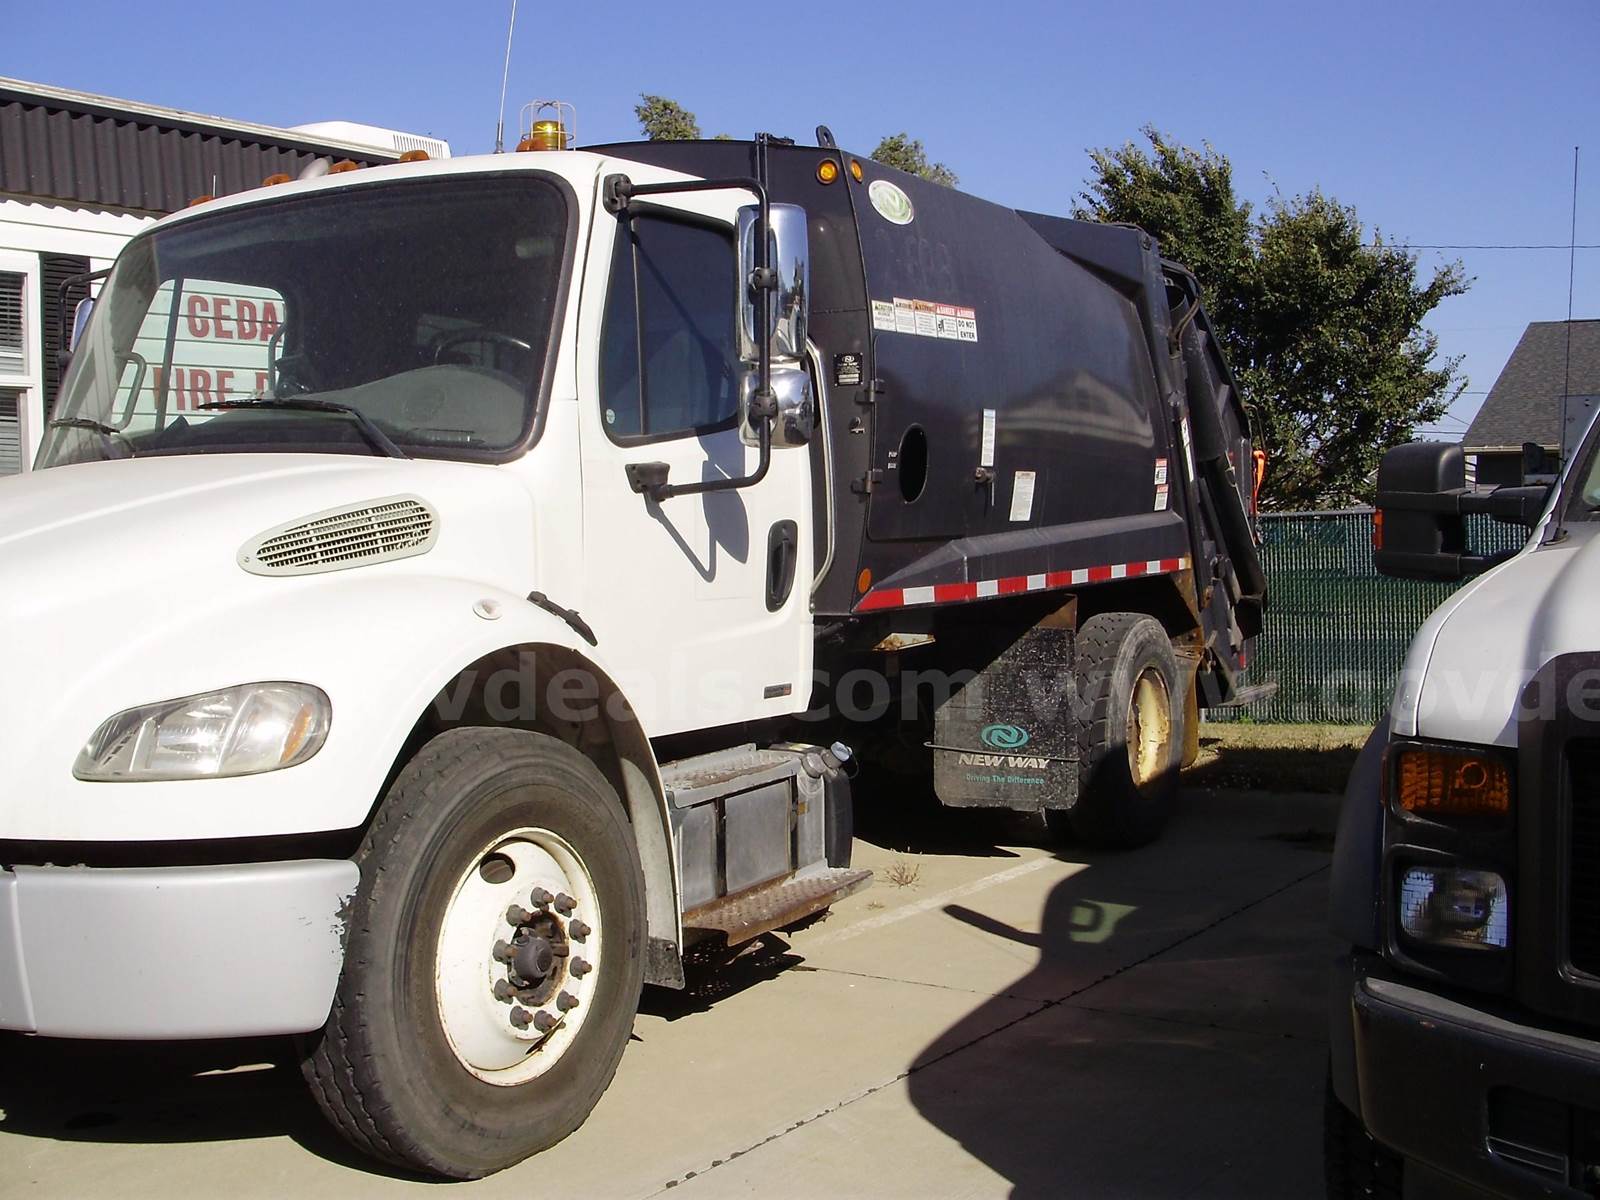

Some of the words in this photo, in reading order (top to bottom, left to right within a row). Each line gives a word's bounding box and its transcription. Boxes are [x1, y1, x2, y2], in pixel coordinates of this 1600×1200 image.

[187, 294, 283, 342] CEDA
[958, 320, 965, 328] DO
[966, 321, 975, 329] NOT
[960, 331, 975, 339] ENTER
[958, 753, 1005, 767] NEW
[1007, 756, 1050, 769] WAY
[966, 774, 990, 783] Driving
[993, 775, 1005, 783] The
[1007, 775, 1044, 785] Difference
